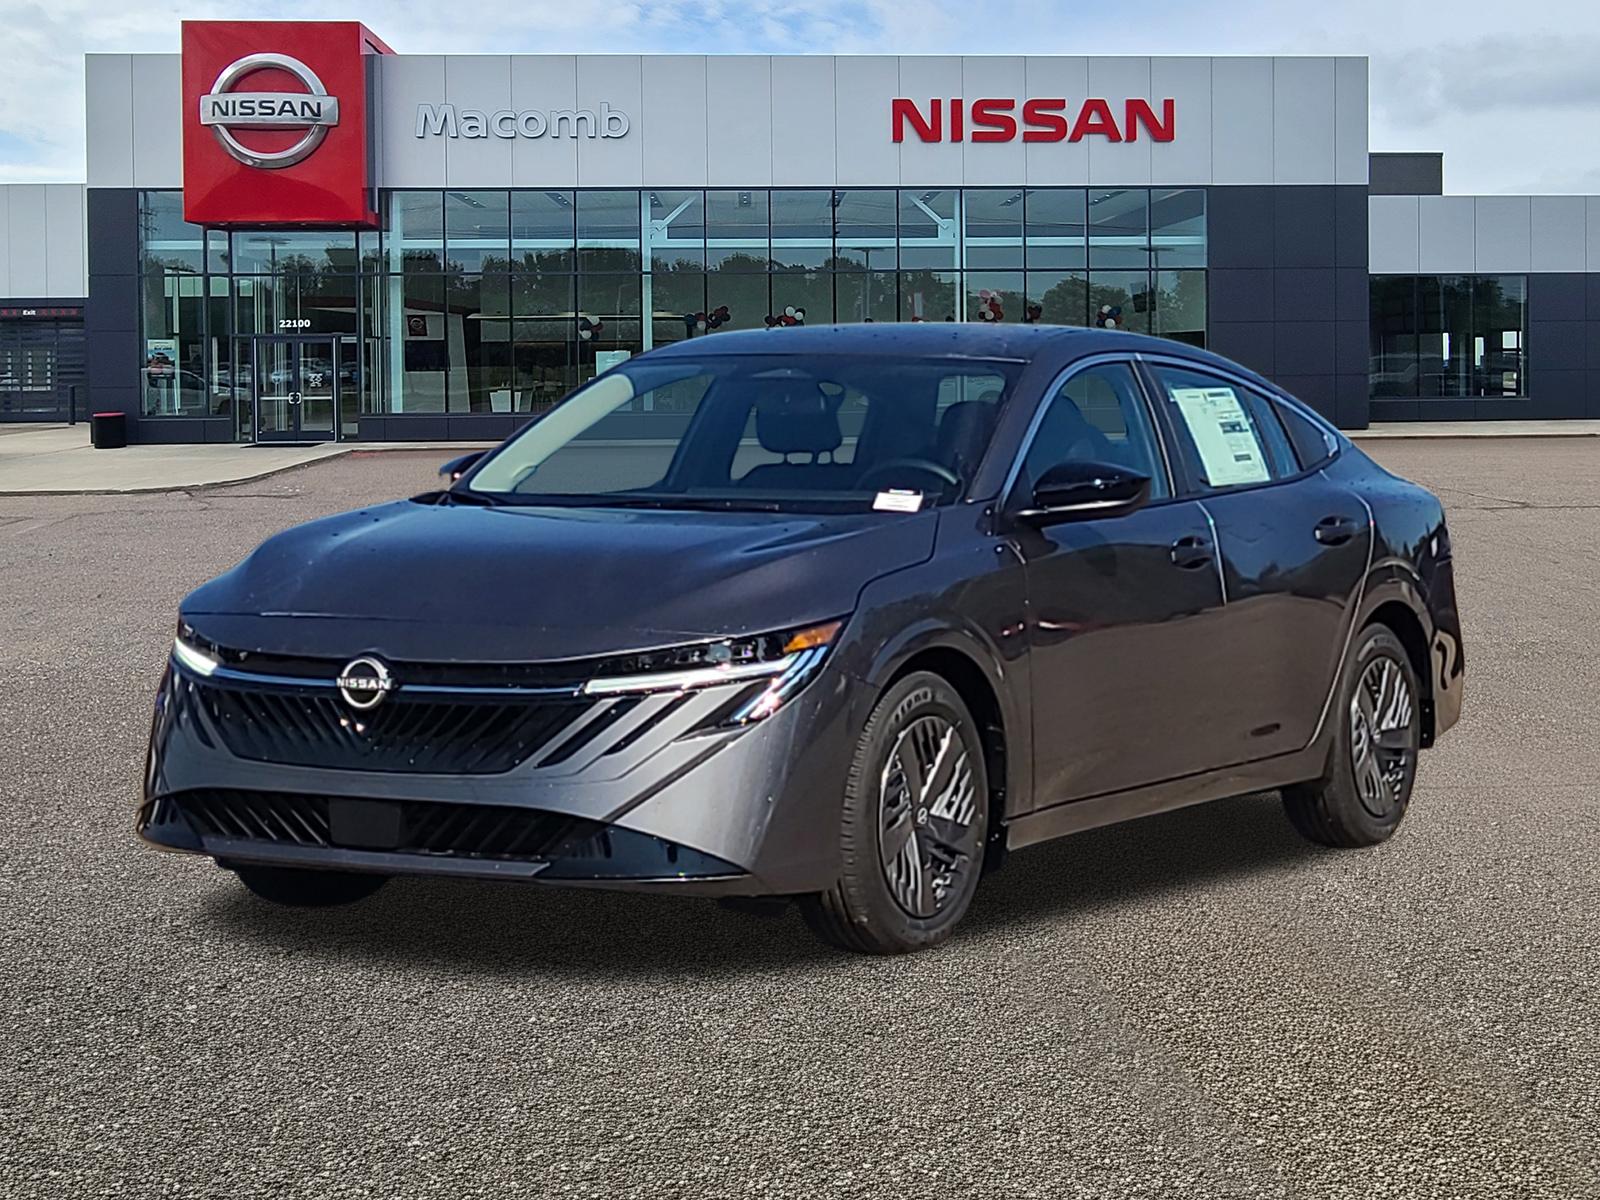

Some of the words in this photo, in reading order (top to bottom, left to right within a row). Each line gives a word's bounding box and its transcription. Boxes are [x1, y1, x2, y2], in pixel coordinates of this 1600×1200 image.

[211, 99, 322, 118] NISSAN
[415, 102, 630, 139] Macomb
[892, 98, 1175, 143] NISSAN
[279, 319, 311, 328] 22100
[336, 677, 391, 690] NISSAN
